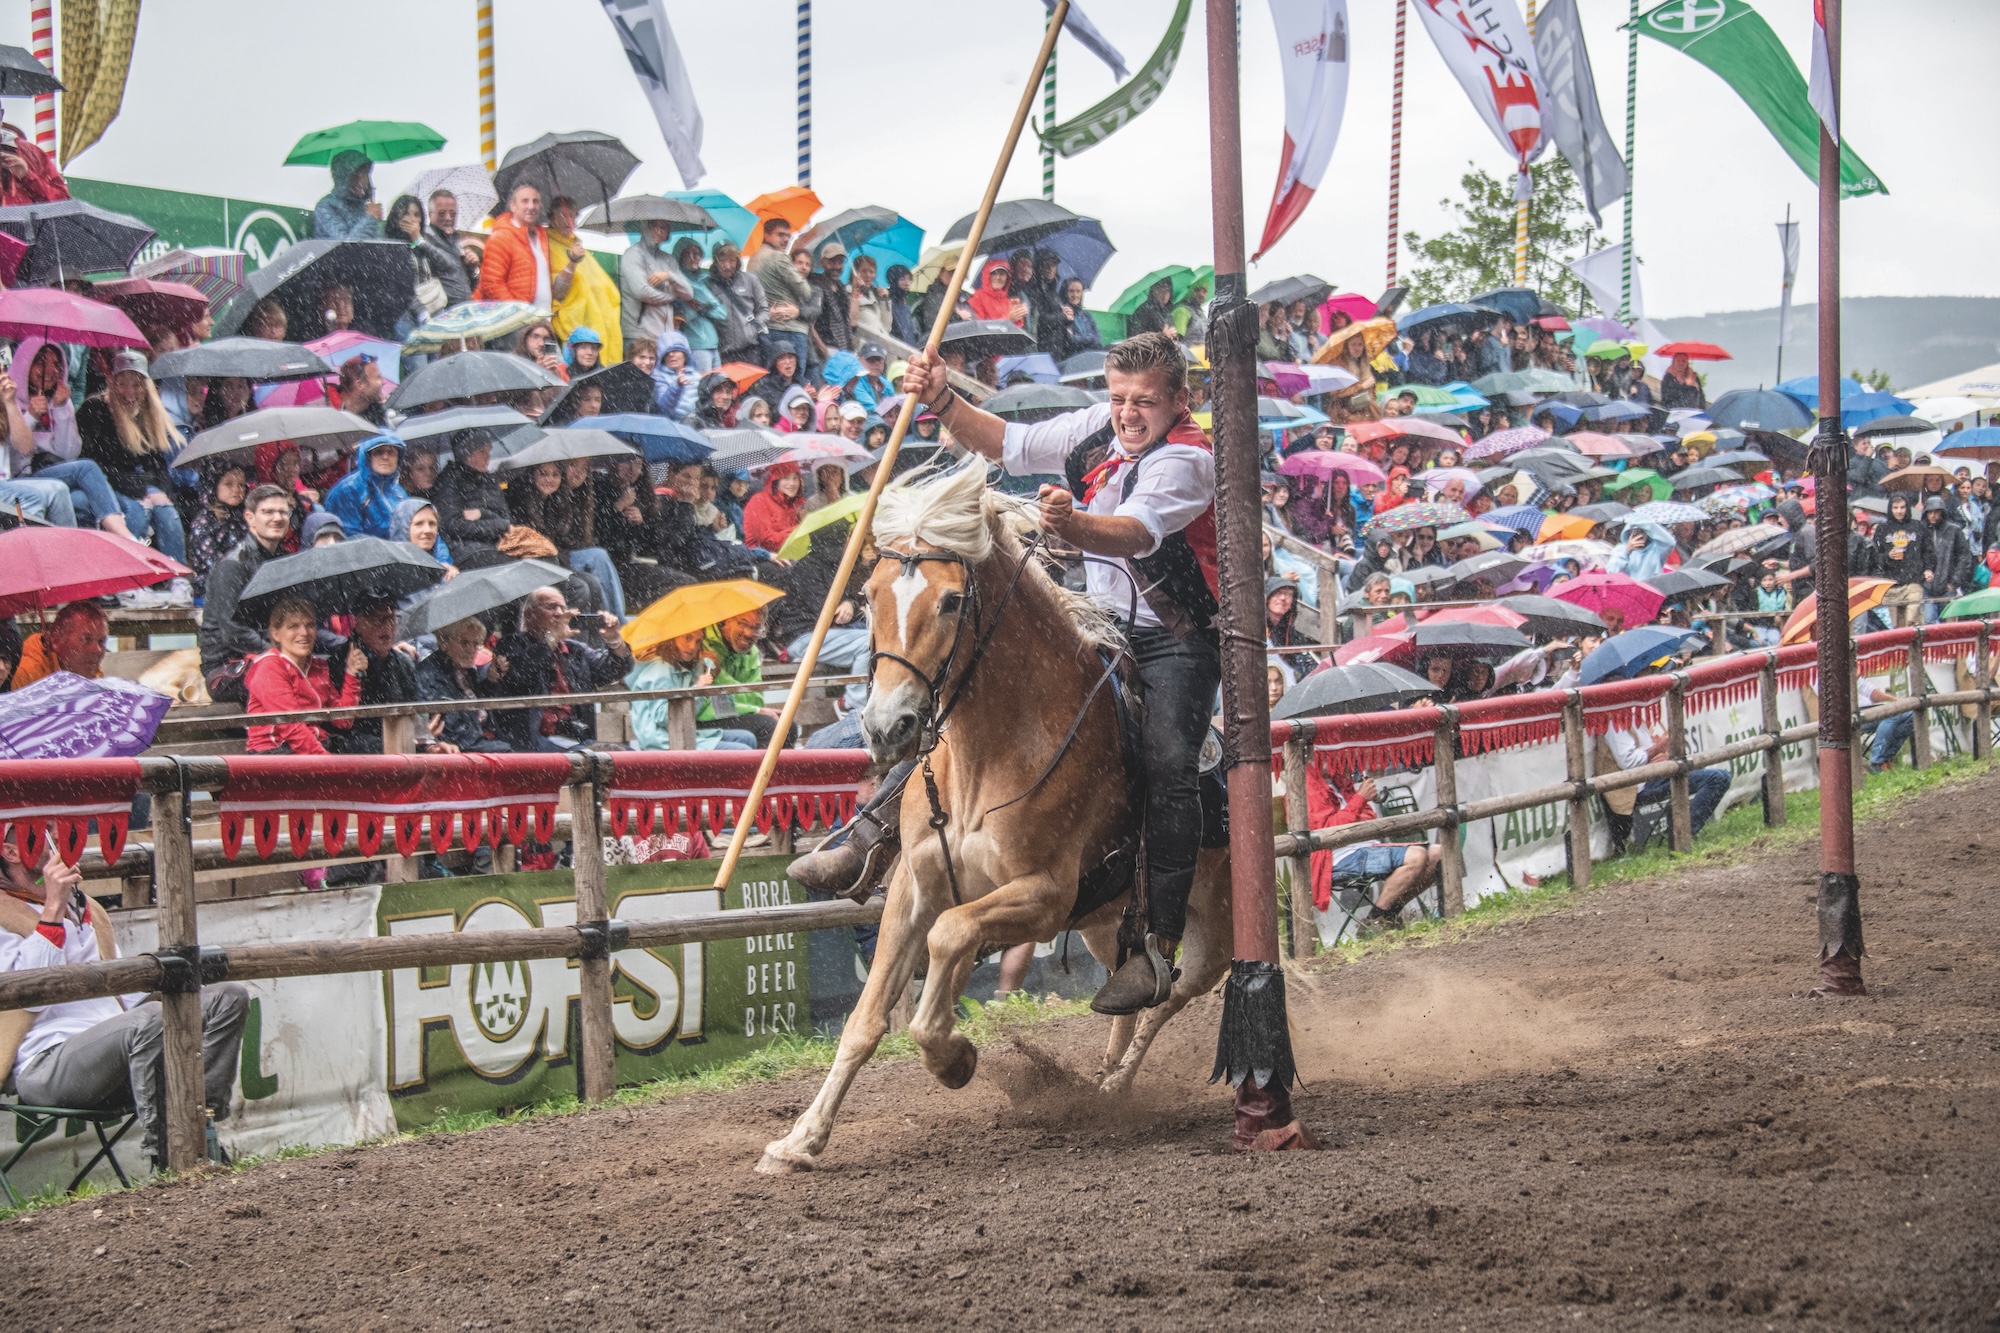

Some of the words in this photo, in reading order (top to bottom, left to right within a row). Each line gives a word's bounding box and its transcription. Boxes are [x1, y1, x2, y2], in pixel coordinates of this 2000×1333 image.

[742, 880, 792, 910] BIRRA
[747, 961, 796, 996] BEER
[745, 1002, 796, 1038] BIER
